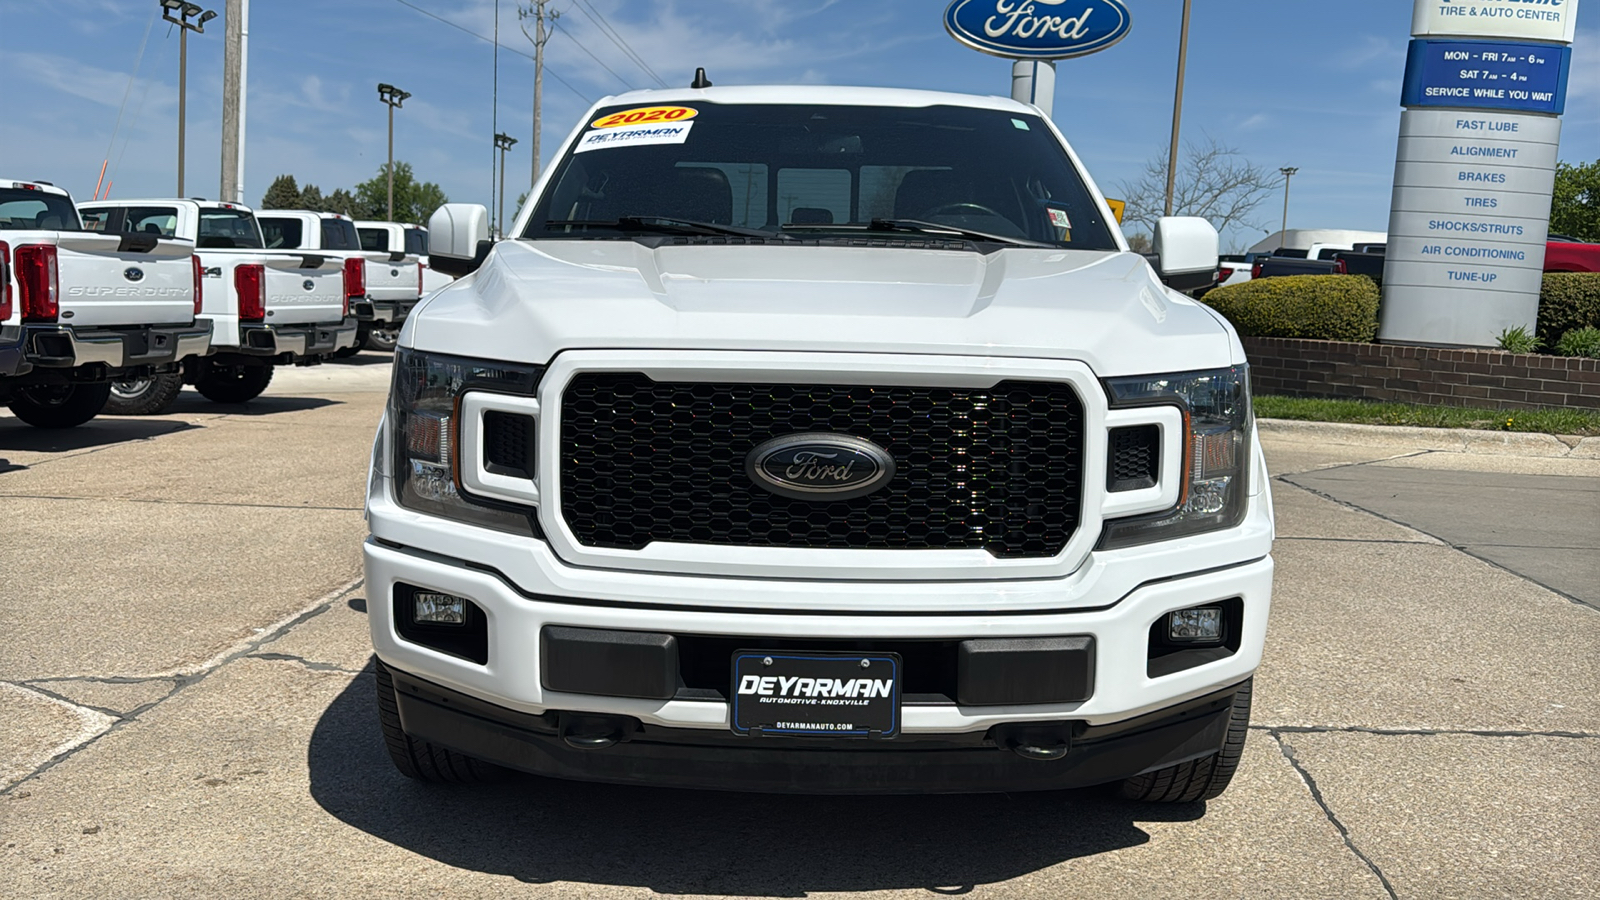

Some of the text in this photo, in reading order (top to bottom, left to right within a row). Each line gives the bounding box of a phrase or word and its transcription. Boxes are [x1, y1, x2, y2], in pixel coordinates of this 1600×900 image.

[984, 0, 1094, 40] Ford
[1439, 6, 1560, 22] TIRE & AUTO CENTER
[1444, 51, 1469, 61] MON
[1482, 52, 1498, 62] FRI
[1460, 70, 1480, 79] SAT
[1425, 87, 1553, 102] SERVICE WHILE YOU WAIT
[600, 109, 688, 127] 2020
[1456, 119, 1519, 132] FAST LUBE
[587, 127, 684, 142] DEYARMAN
[1450, 146, 1518, 158] ALIGNMENT
[1458, 171, 1506, 183] BRAKES
[1464, 197, 1498, 208] TIRES
[1428, 220, 1523, 235] SHOCKS/STRUTS
[1421, 245, 1525, 261] AIR CONDITIONING
[1447, 271, 1497, 283] TUNE-UP
[68, 286, 189, 297] SUPER DUTY
[270, 295, 314, 303] SUPER
[785, 451, 855, 481] Ford
[738, 675, 893, 698] DEYARMAN
[776, 721, 853, 731] DEYARMANAUTO.COM
